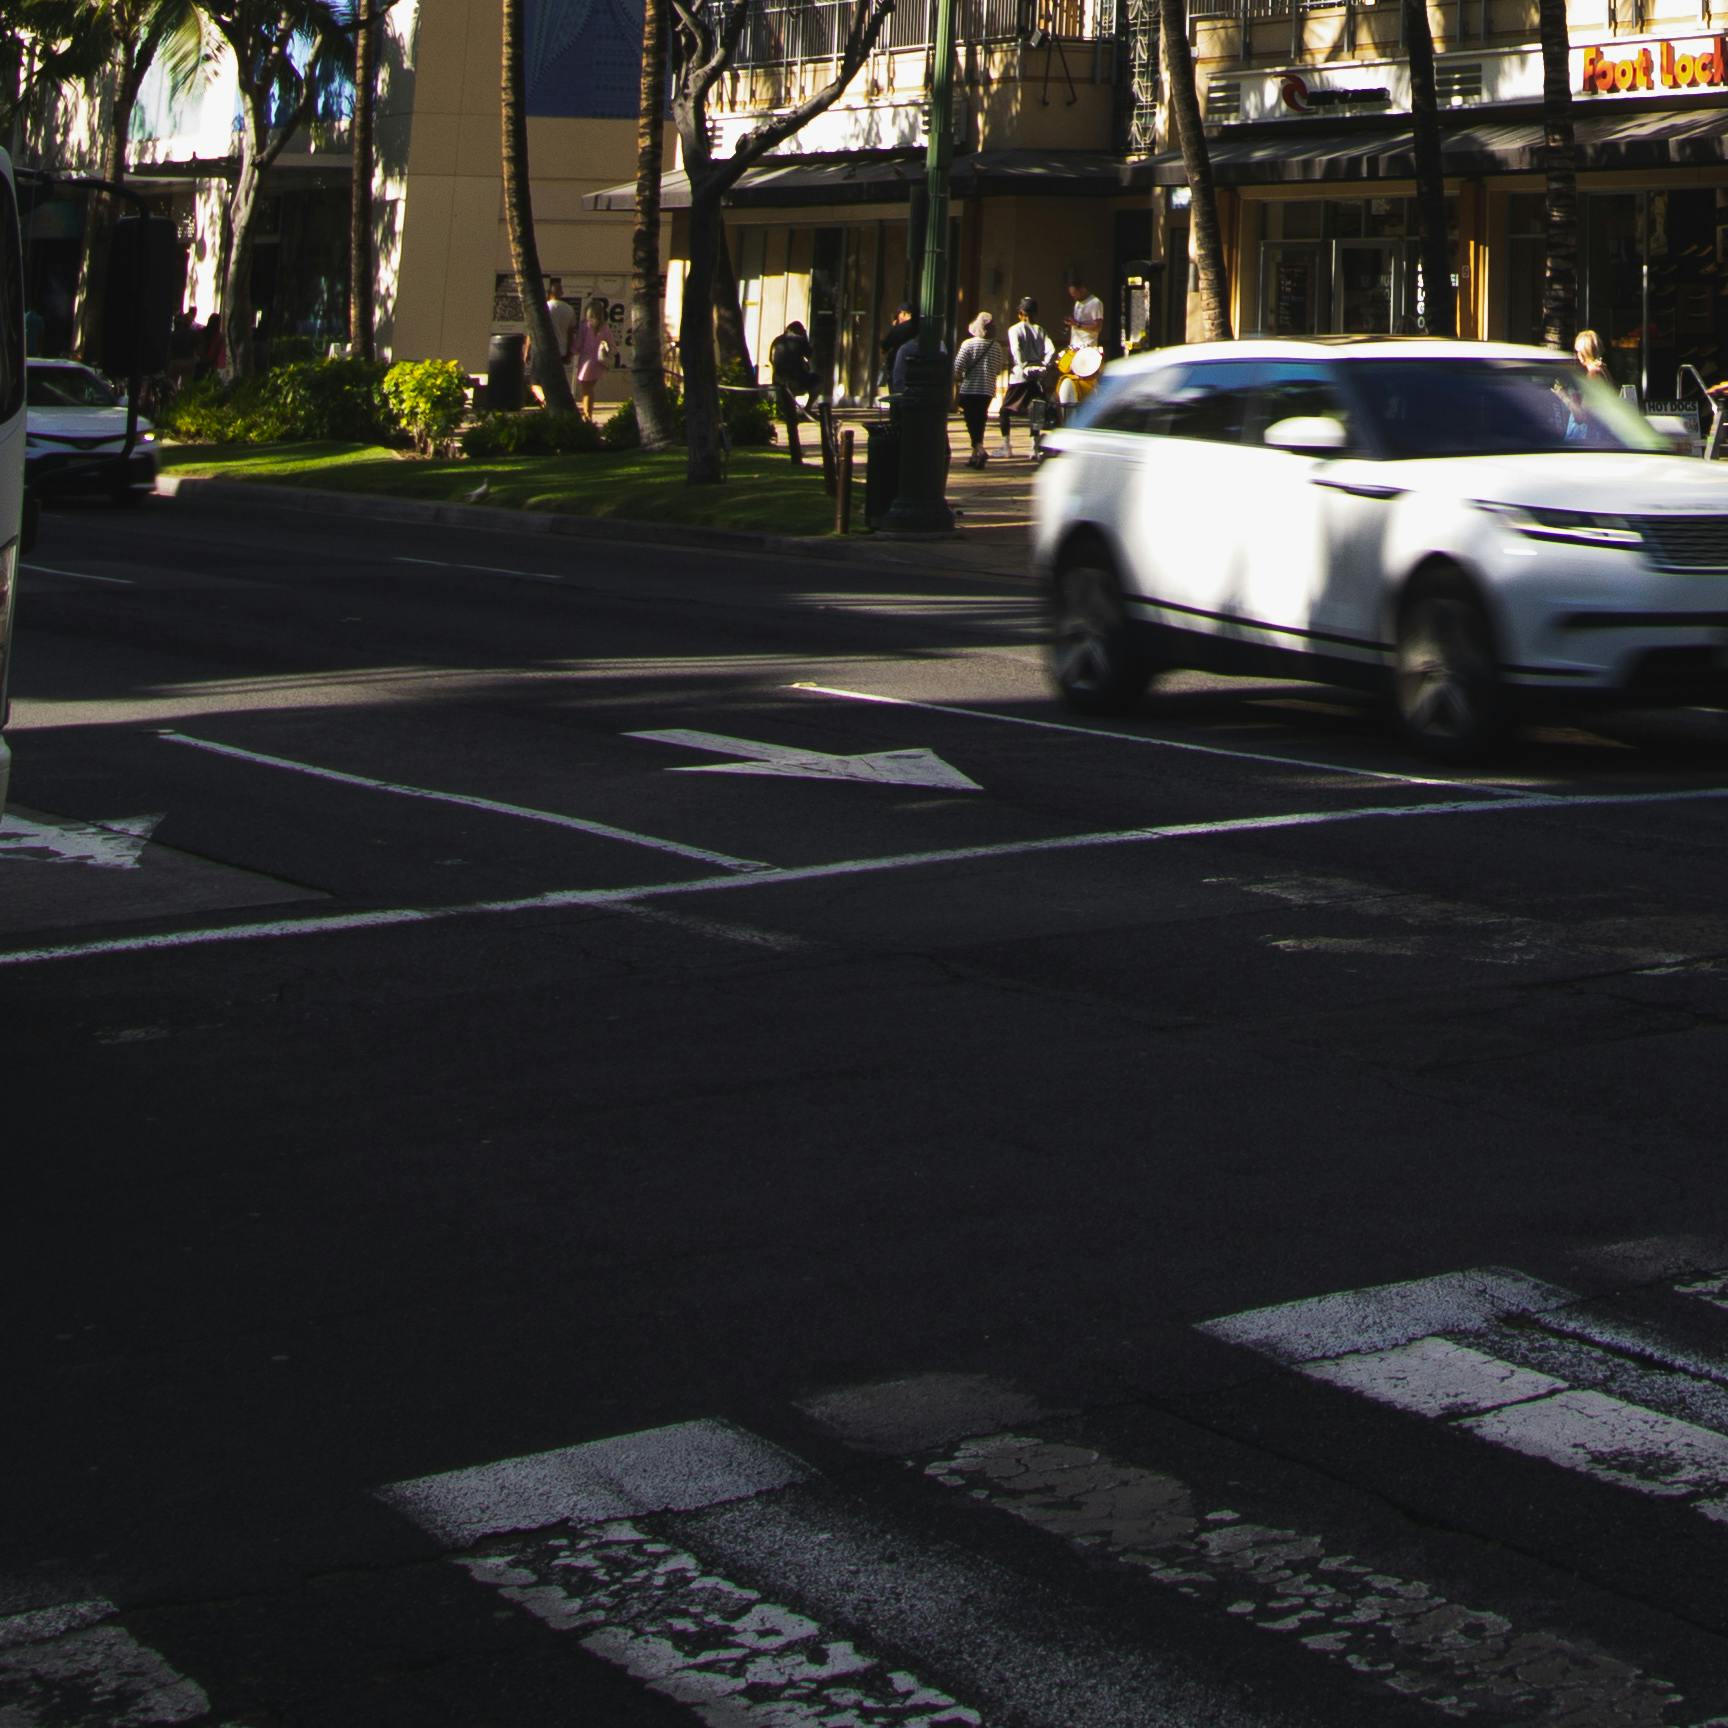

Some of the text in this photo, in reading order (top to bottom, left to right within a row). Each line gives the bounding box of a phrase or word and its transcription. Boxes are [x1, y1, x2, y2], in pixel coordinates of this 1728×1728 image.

[1583, 46, 1653, 92] Foot
[1649, 400, 1697, 412] HOT DOGS
